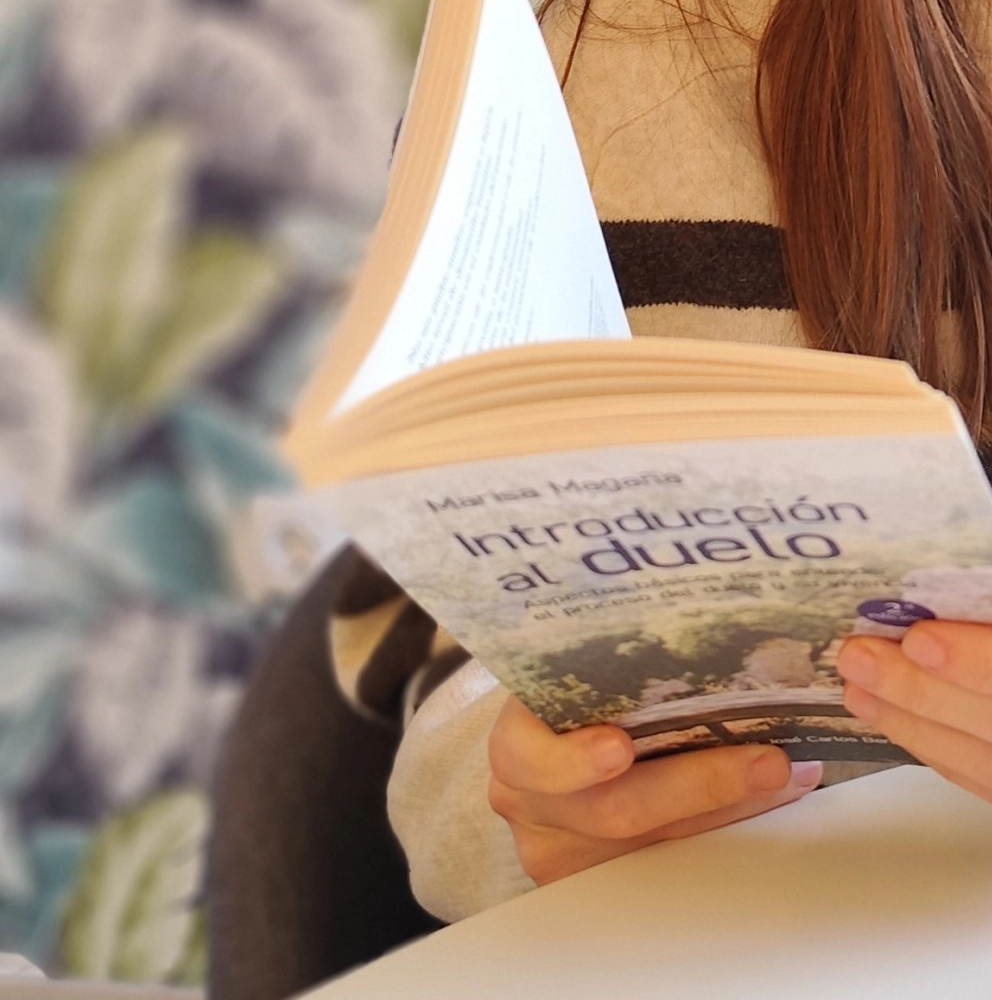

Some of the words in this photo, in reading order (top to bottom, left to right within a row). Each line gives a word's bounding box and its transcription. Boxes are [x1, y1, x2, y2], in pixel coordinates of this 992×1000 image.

[426, 487, 540, 513] Marisa
[548, 472, 682, 496] Magaña
[453, 495, 868, 557] Introducción
[497, 563, 562, 593] al
[581, 526, 841, 576] duelo
[524, 586, 629, 610] Aspectos
[635, 573, 722, 589] básicos
[533, 608, 555, 621] el
[563, 594, 652, 616] proceso
[660, 586, 693, 603] del
[806, 735, 858, 743] Carlos
